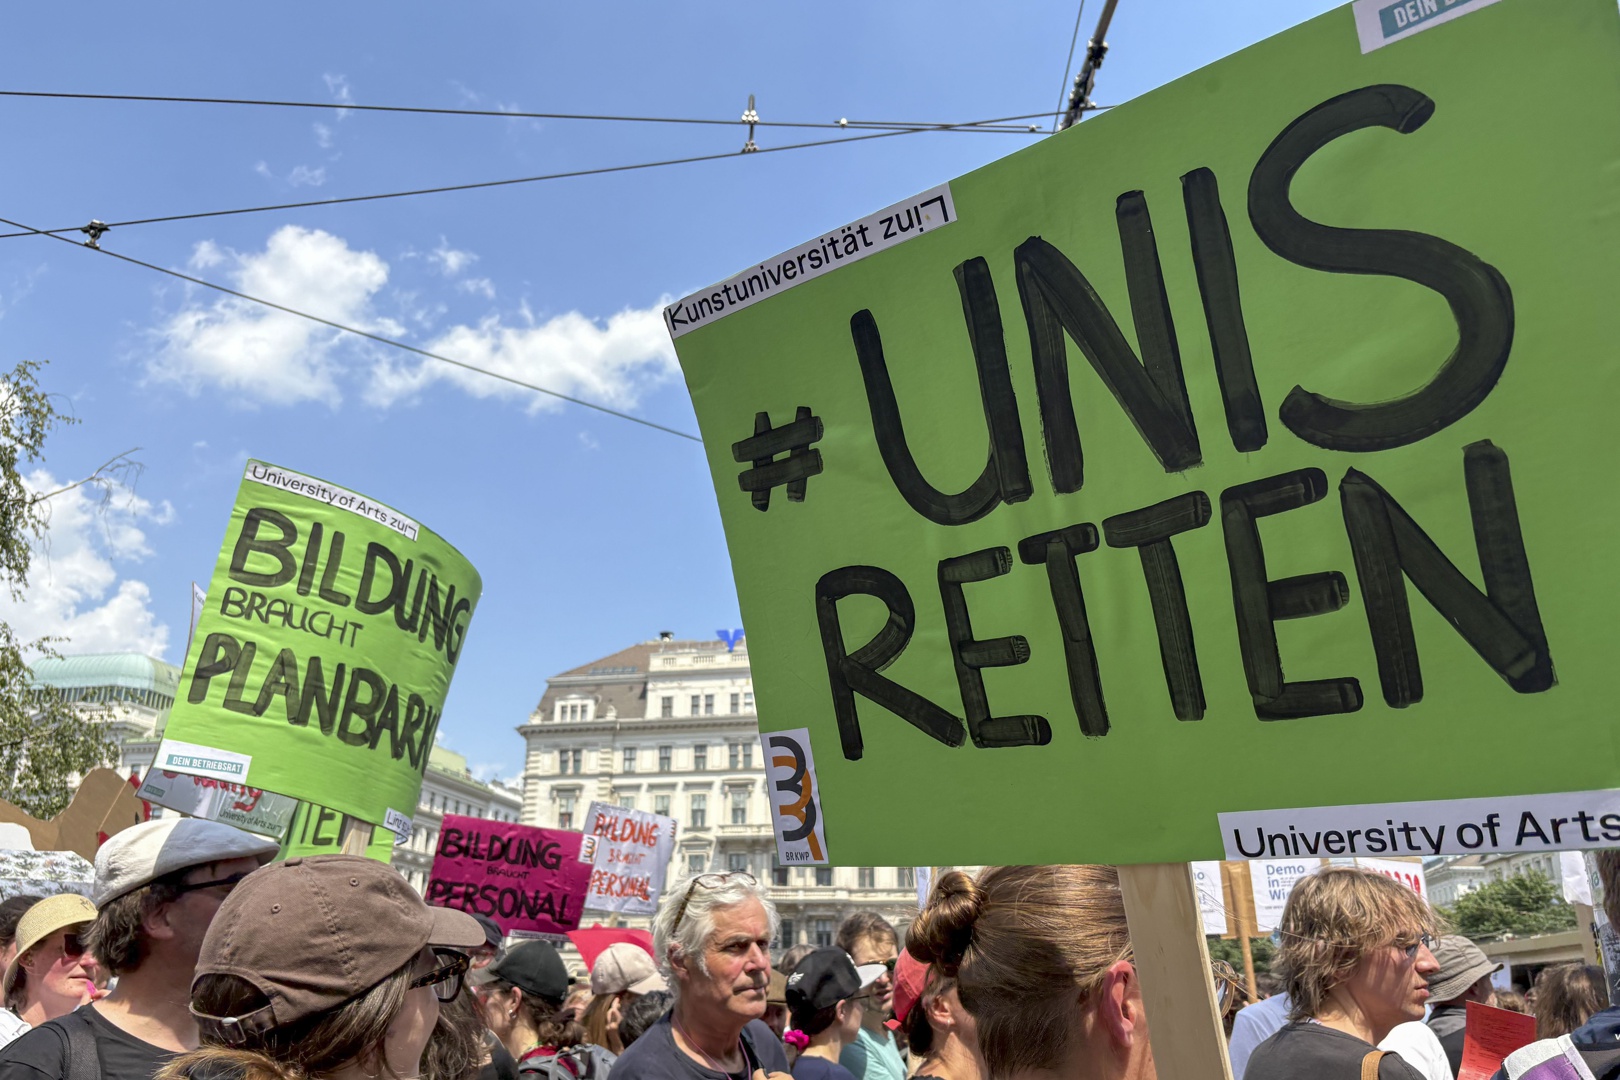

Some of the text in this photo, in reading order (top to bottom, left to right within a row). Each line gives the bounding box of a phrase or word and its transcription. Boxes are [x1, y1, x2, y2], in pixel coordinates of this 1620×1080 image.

[1393, 0, 1438, 28] DEIN
[668, 224, 873, 331] Kunstuniversität
[252, 465, 338, 505] University
[339, 494, 356, 507] of
[356, 501, 387, 522] Arts
[228, 507, 471, 665] BILDUNG
[816, 439, 1559, 760] RETTEN
[220, 587, 364, 648] BRAUCHT
[187, 632, 440, 777] PLANBARK
[172, 756, 242, 773] DEIN BETRIEBSRAT
[440, 828, 562, 870] BILDUNG
[593, 813, 659, 847] BILDUNG
[1233, 810, 1620, 858] University of Arts
[486, 866, 530, 879] BRAUCHT
[1266, 864, 1305, 875] Demo
[1267, 877, 1280, 888] in
[429, 878, 573, 926] PERSONAL
